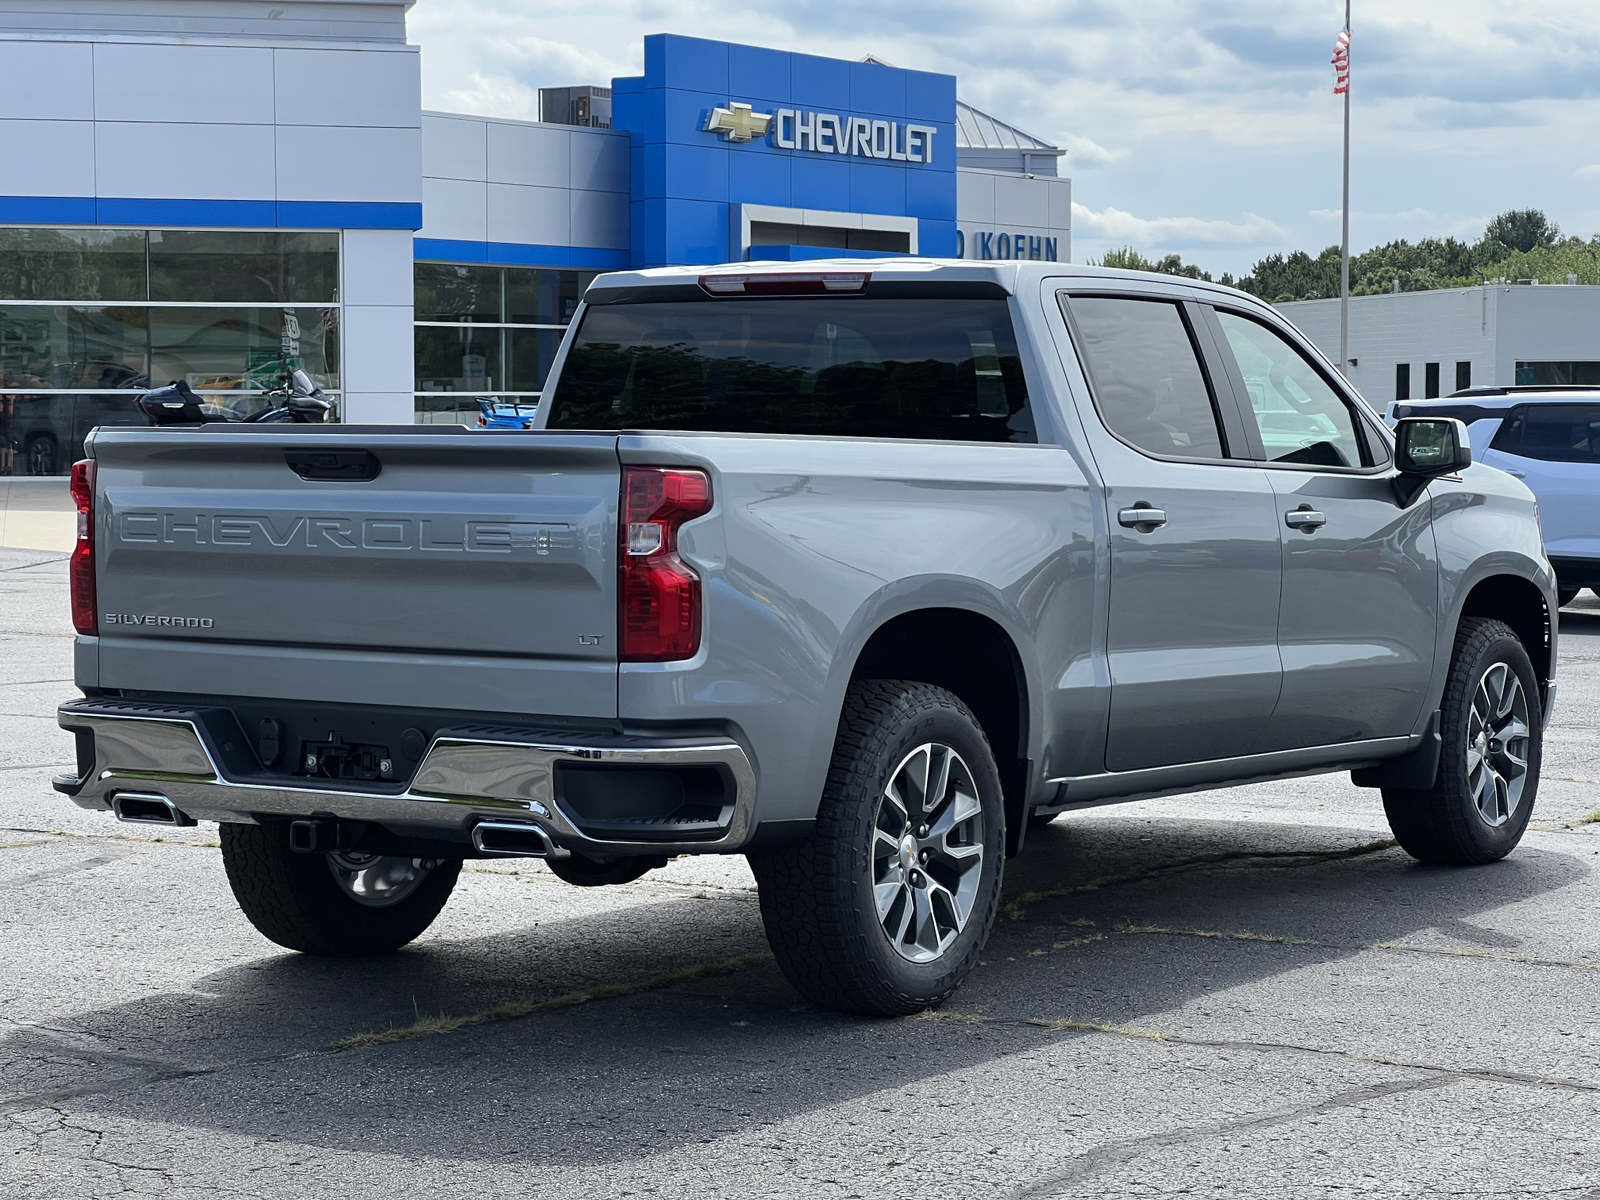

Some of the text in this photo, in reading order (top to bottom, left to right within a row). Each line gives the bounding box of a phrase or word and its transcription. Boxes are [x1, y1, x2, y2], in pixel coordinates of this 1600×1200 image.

[777, 107, 938, 164] CHEVROLET
[119, 511, 578, 557] CHEVROLET
[104, 612, 215, 629] SILVERADO
[578, 634, 604, 646] LT
